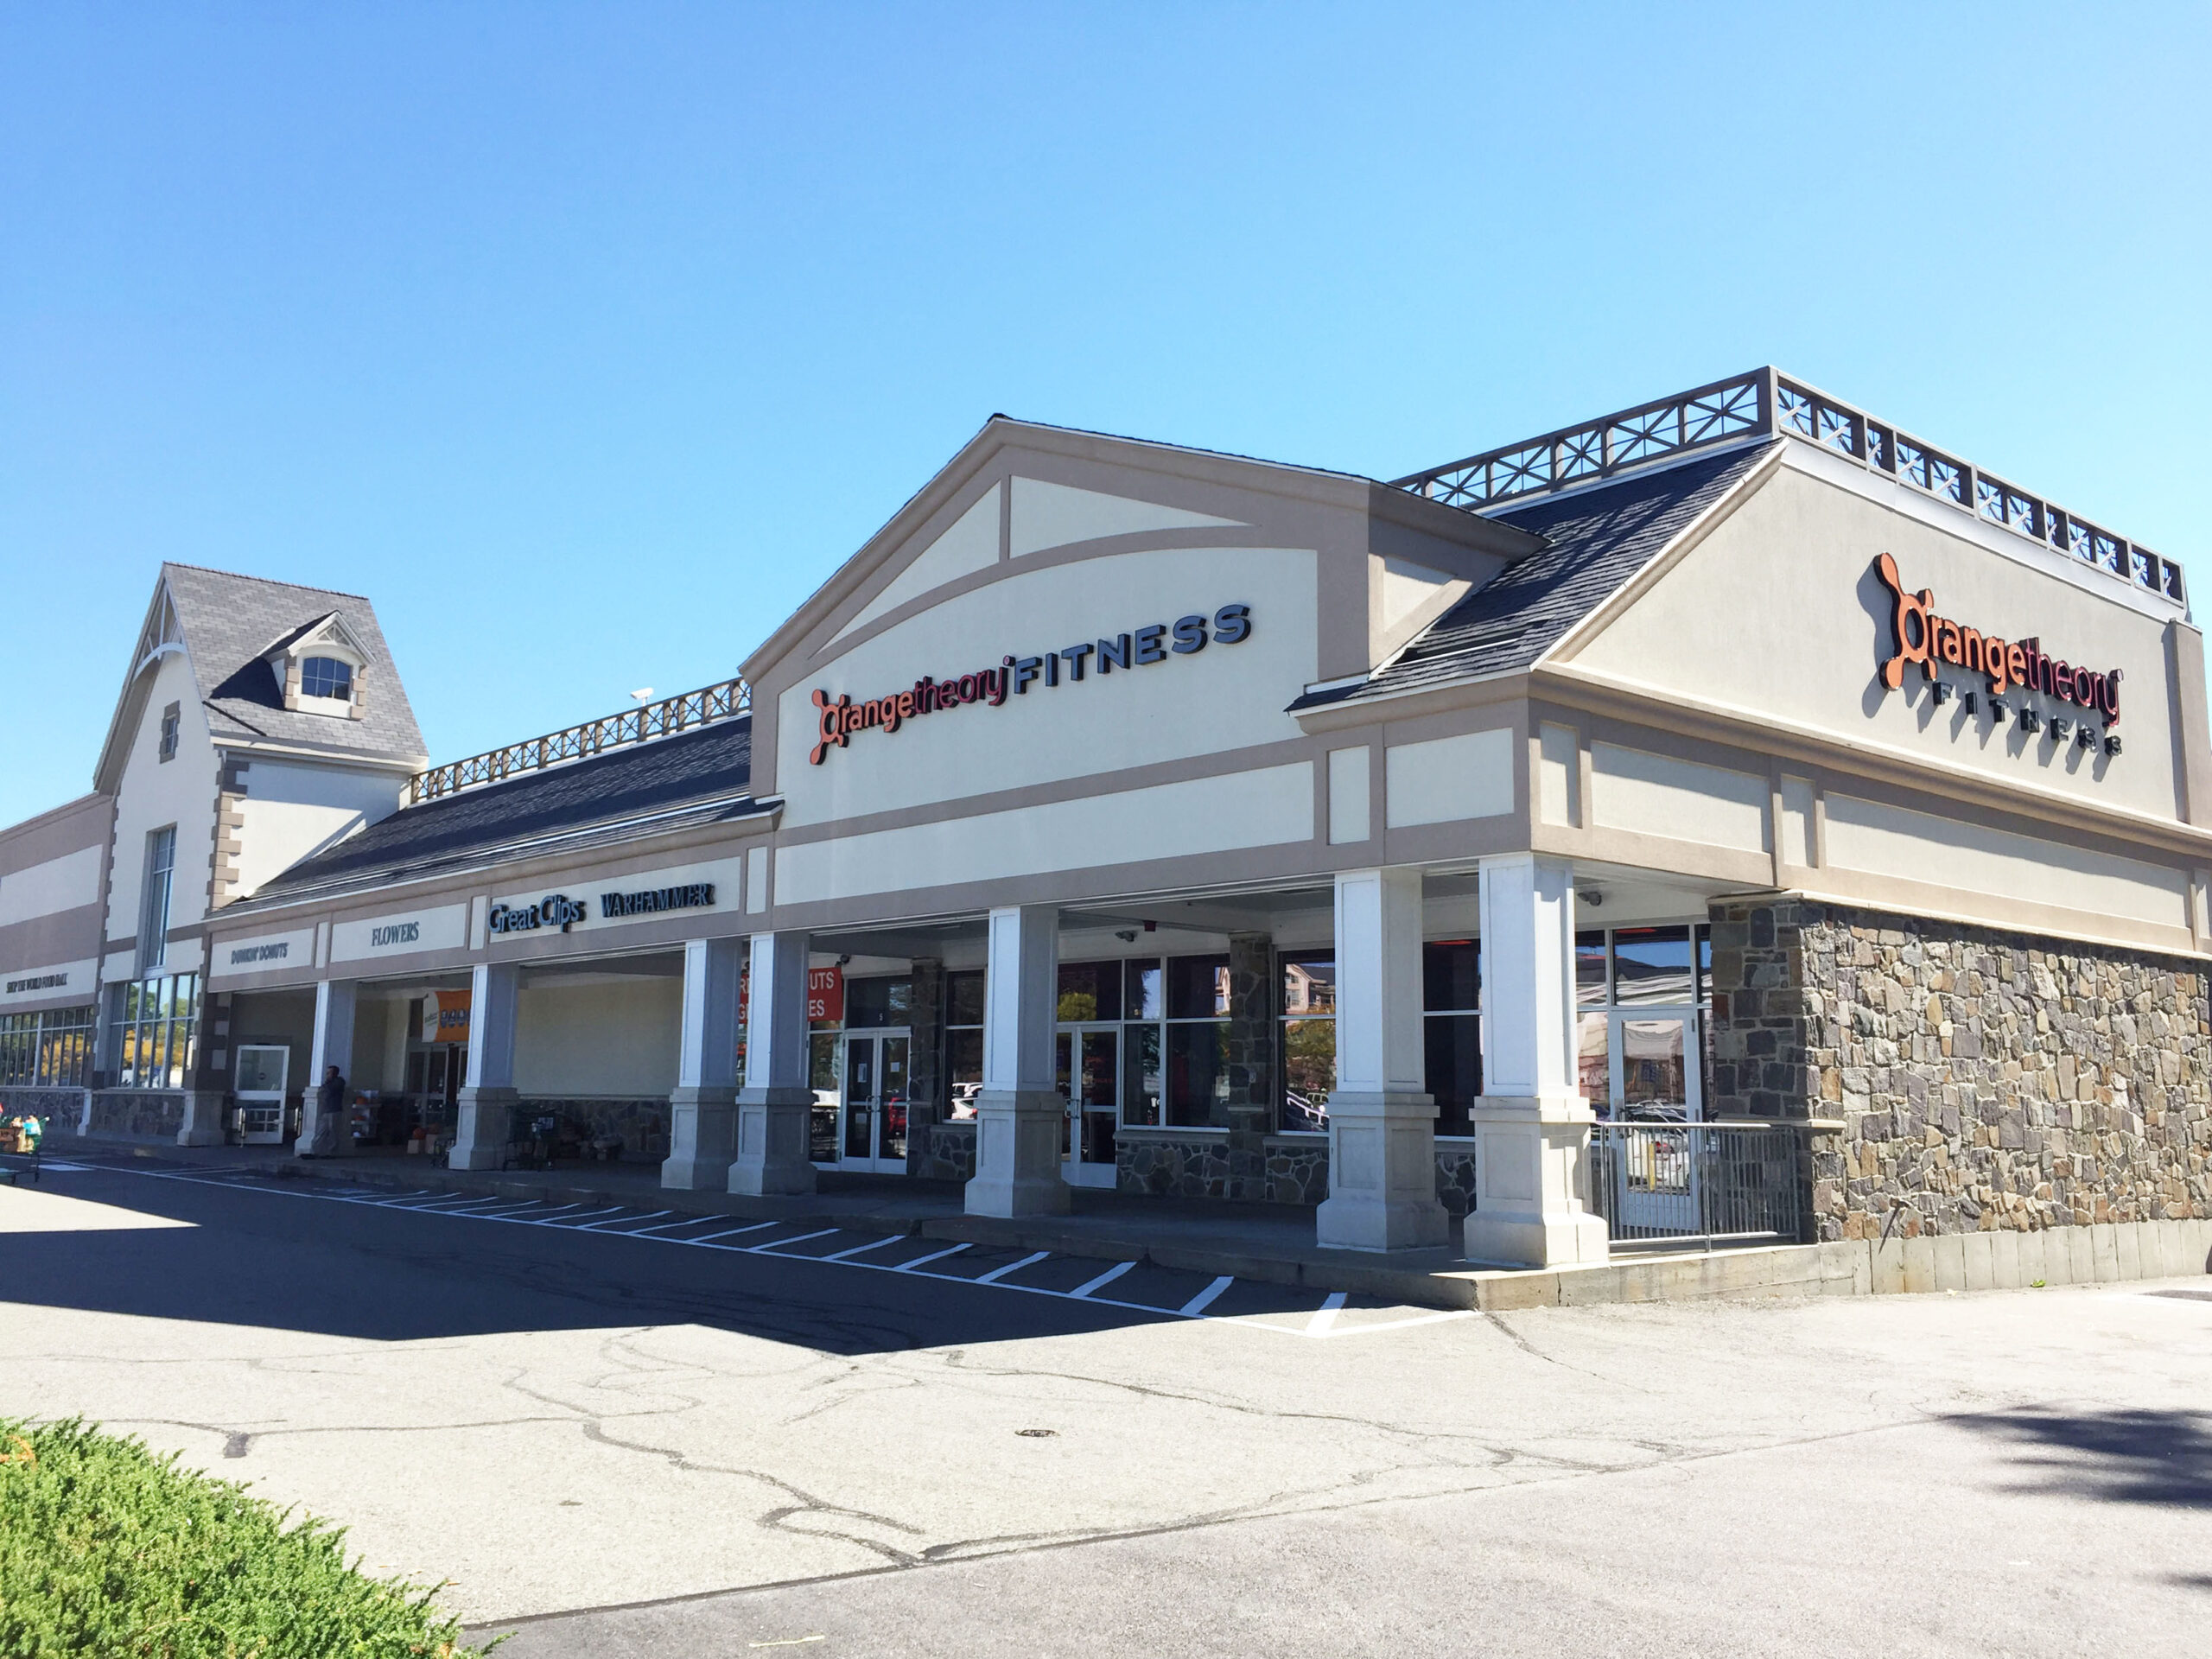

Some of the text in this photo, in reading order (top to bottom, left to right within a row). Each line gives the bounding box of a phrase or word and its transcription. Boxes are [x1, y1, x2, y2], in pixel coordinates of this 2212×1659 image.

[1014, 604, 1253, 695] FITNESS
[1932, 680, 2123, 758] FITNESS
[488, 883, 716, 934] Great Clips WARHAMMER
[372, 920, 420, 947] FLOWERS
[809, 971, 835, 990] UTS
[808, 999, 825, 1017] ES
